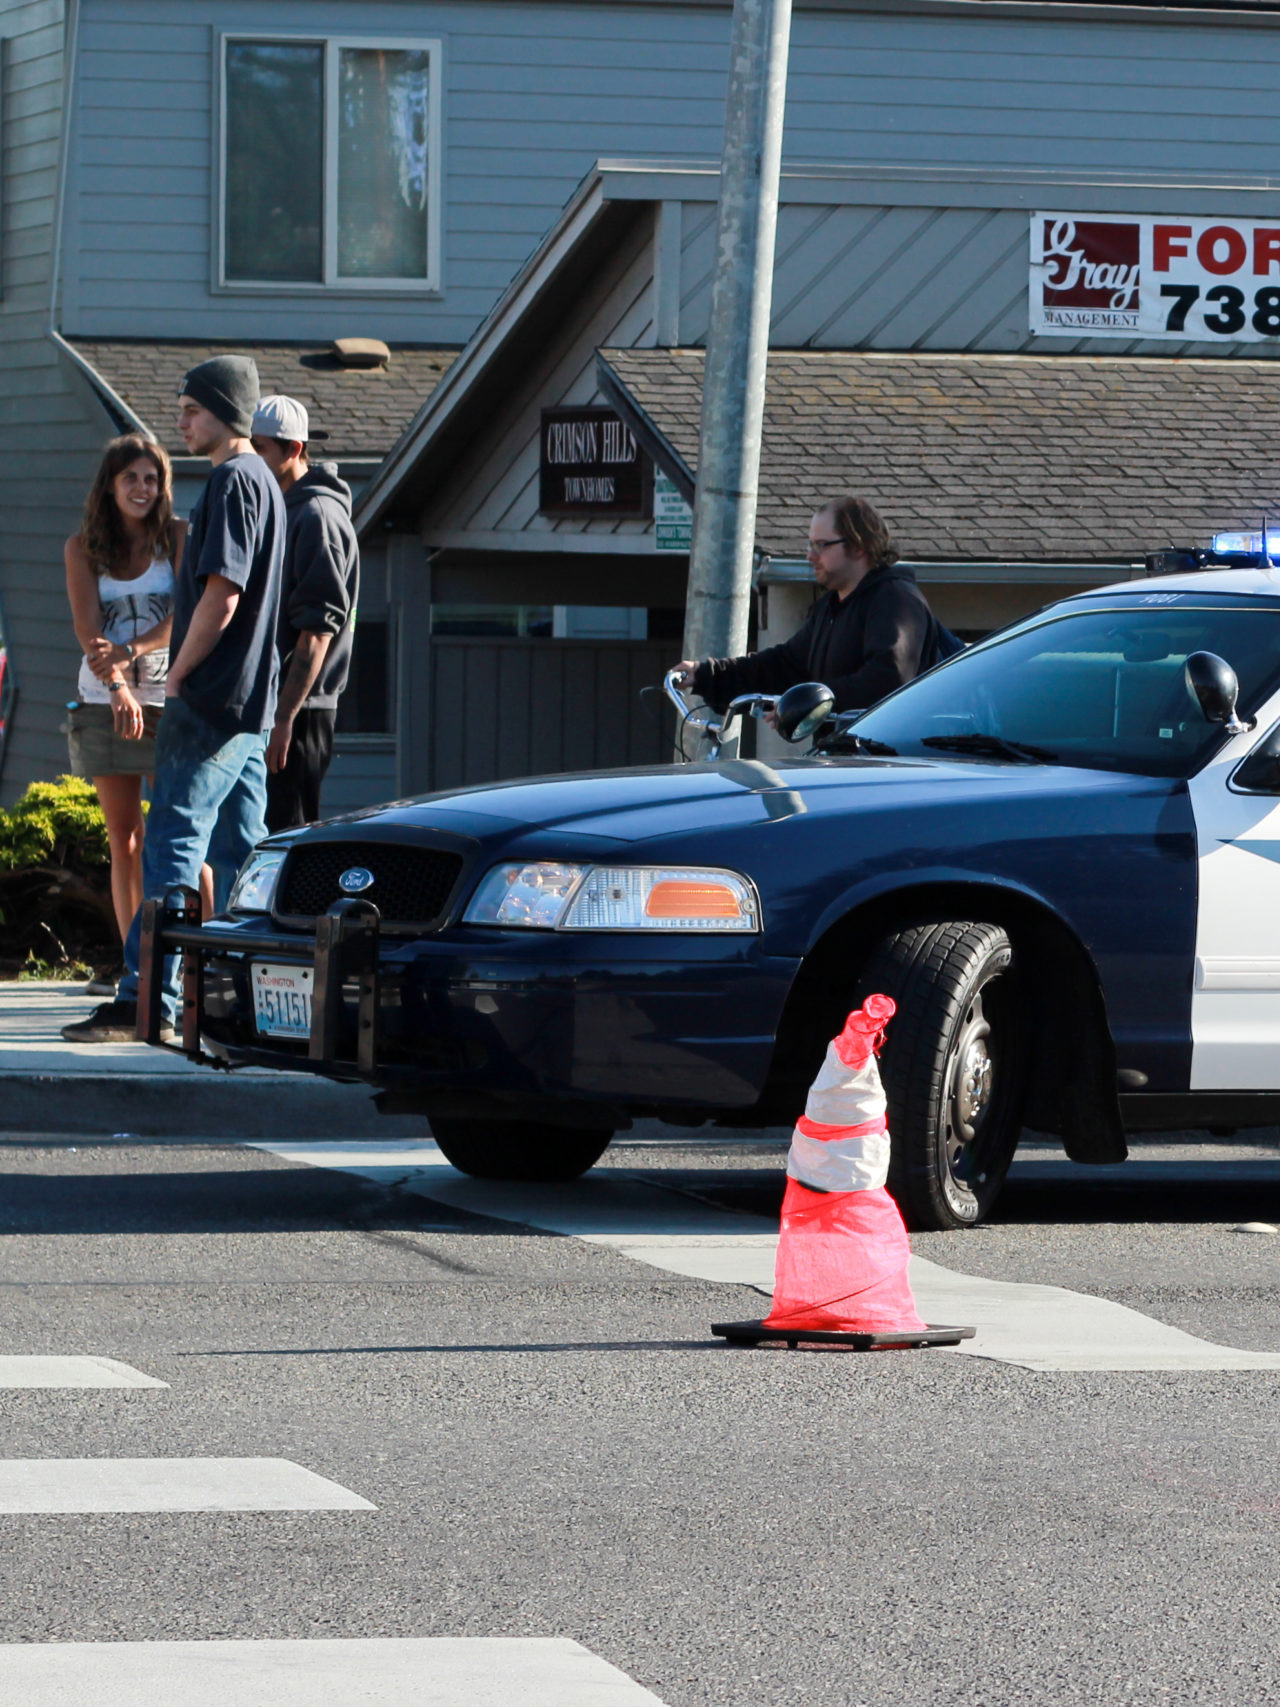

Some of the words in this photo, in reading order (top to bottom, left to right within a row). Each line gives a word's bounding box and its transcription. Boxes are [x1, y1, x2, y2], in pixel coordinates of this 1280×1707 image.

[1042, 219, 1140, 310] Gray
[1043, 310, 1139, 327] MANAGEMENT
[547, 421, 598, 464] CRIMSON
[564, 477, 615, 502] TOWNHOMES
[345, 871, 365, 887] Ford
[256, 976, 295, 988] WASHINGTON
[265, 989, 312, 1027] 51151
